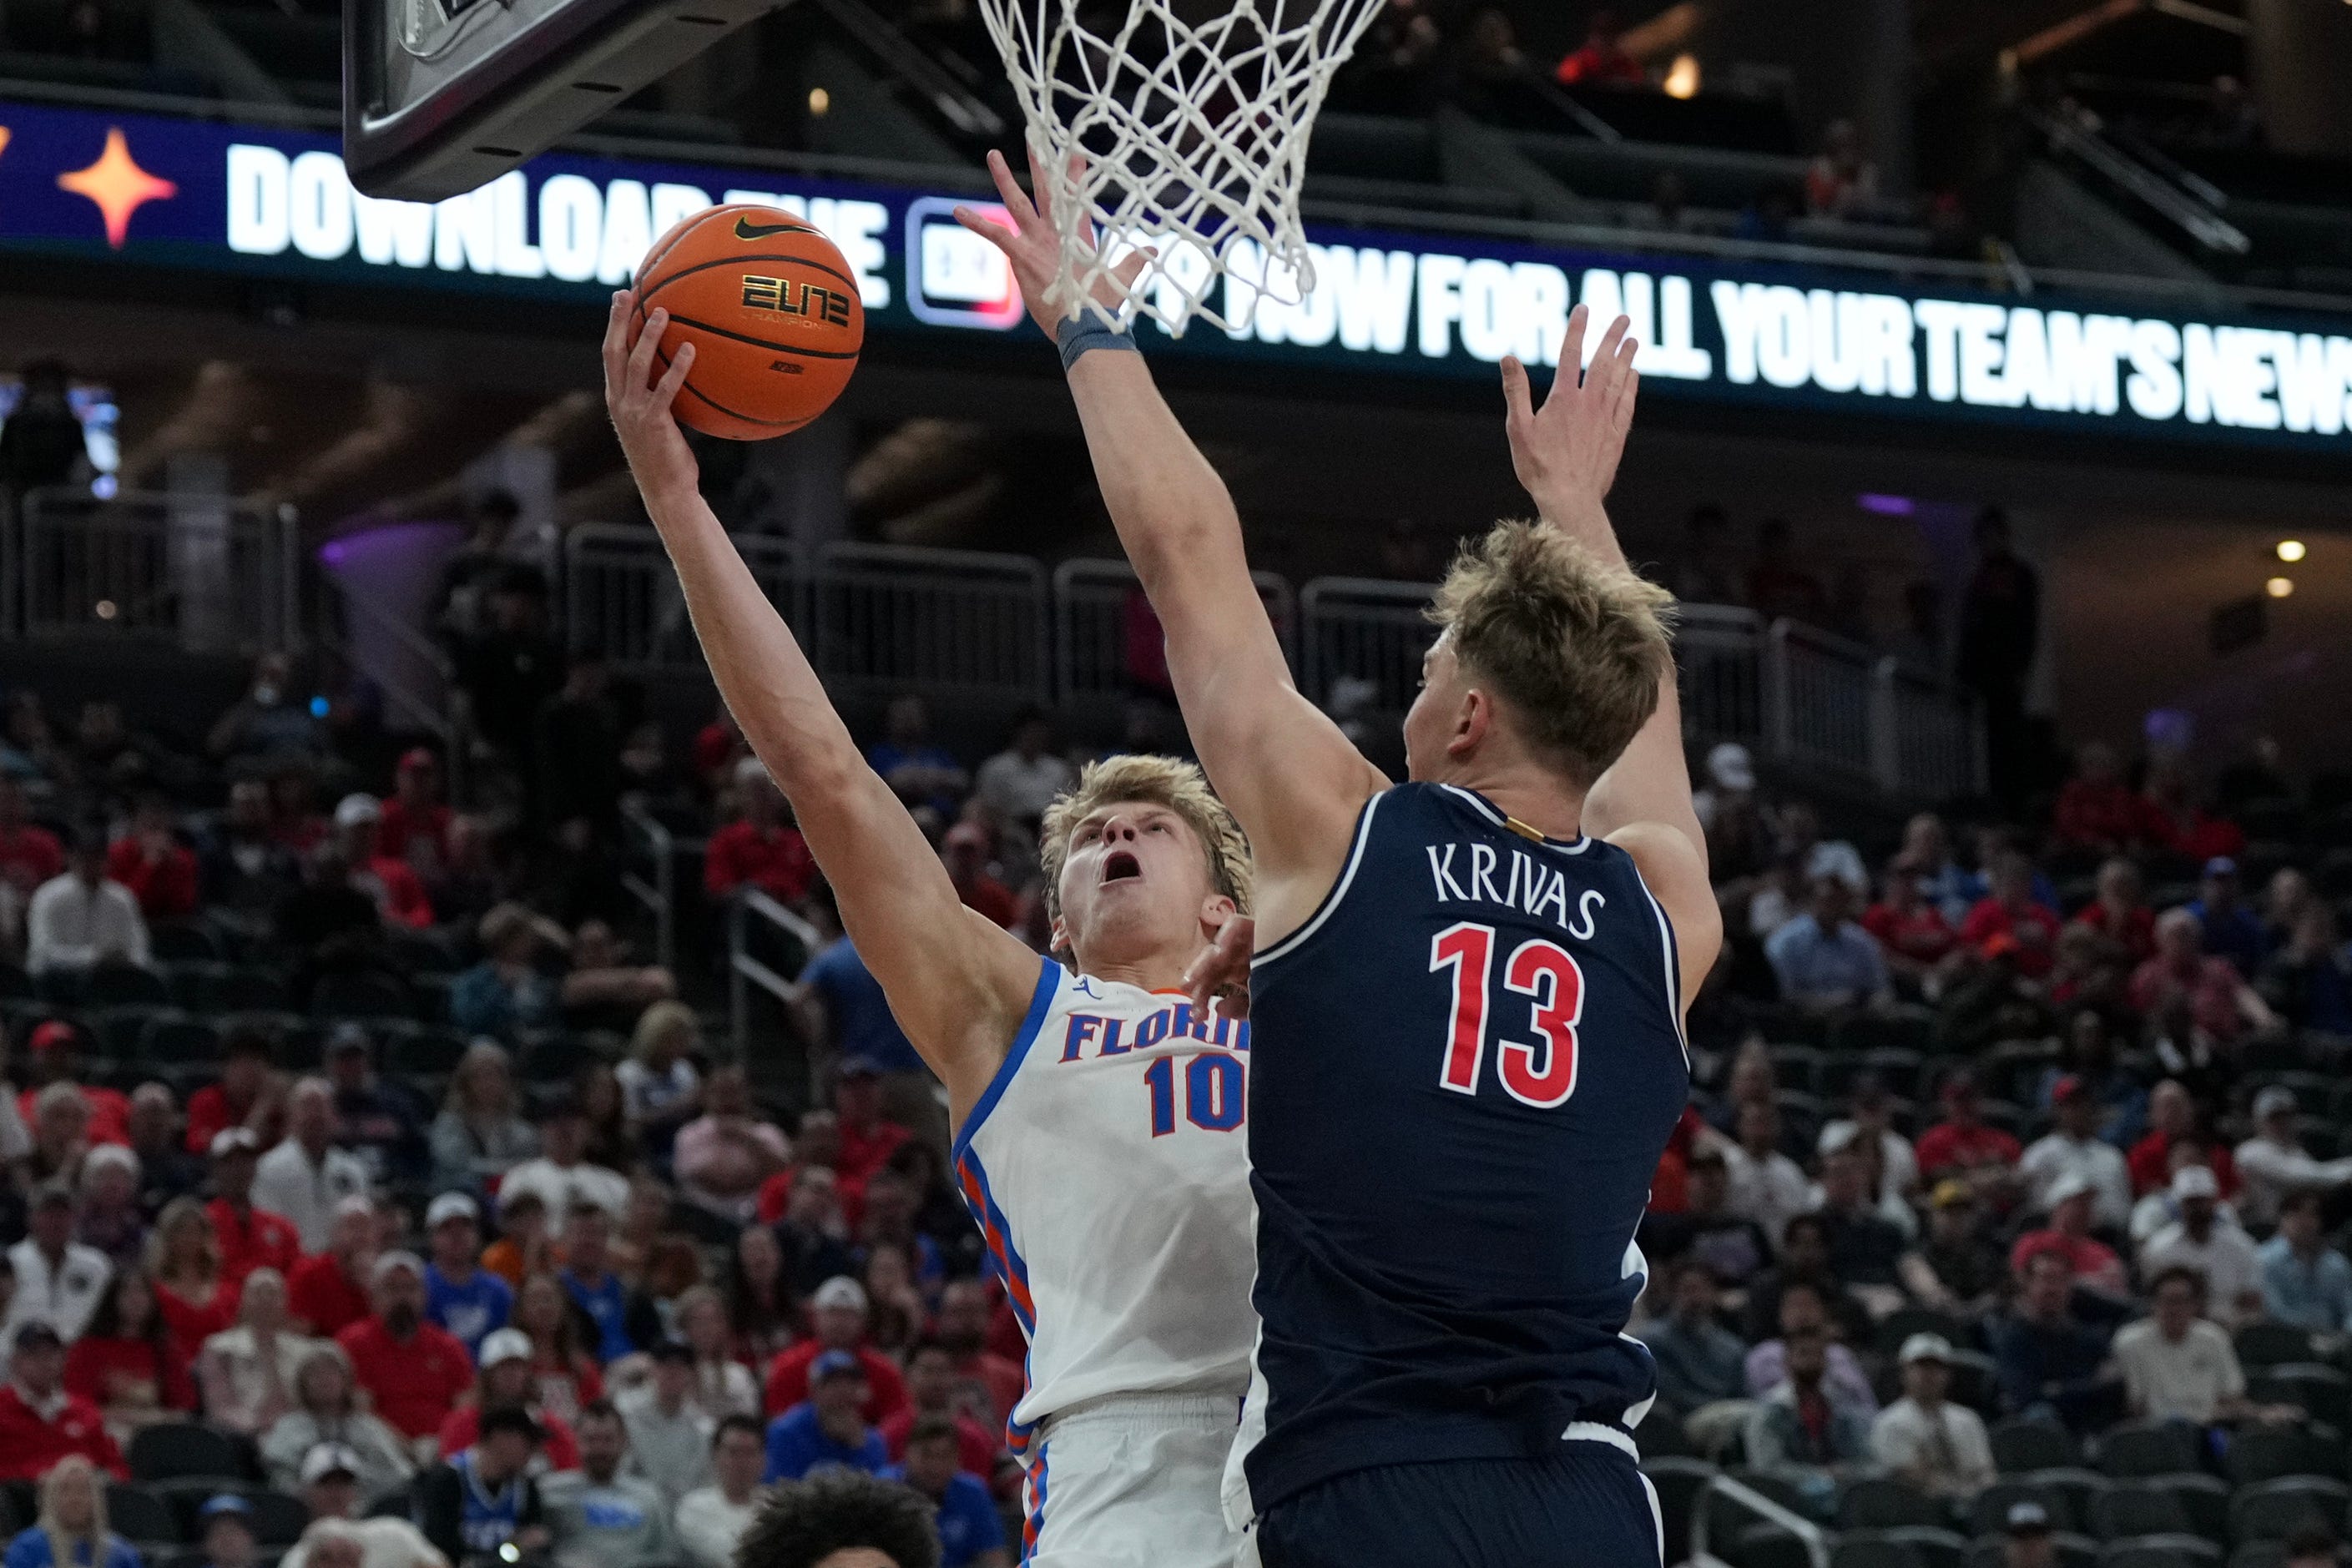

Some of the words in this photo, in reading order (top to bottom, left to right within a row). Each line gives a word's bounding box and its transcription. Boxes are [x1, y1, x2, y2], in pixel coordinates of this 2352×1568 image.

[742, 274, 850, 328] ELITE
[1223, 234, 1416, 354] NOW
[1417, 252, 1572, 368] FOR
[1580, 268, 1713, 381] ALL
[1709, 280, 1916, 399] YOUR
[1913, 298, 2184, 421] TEAM'S
[1426, 843, 1606, 940] KRIVAS
[1428, 921, 1586, 1110] 13
[1144, 1052, 1245, 1138] 10
